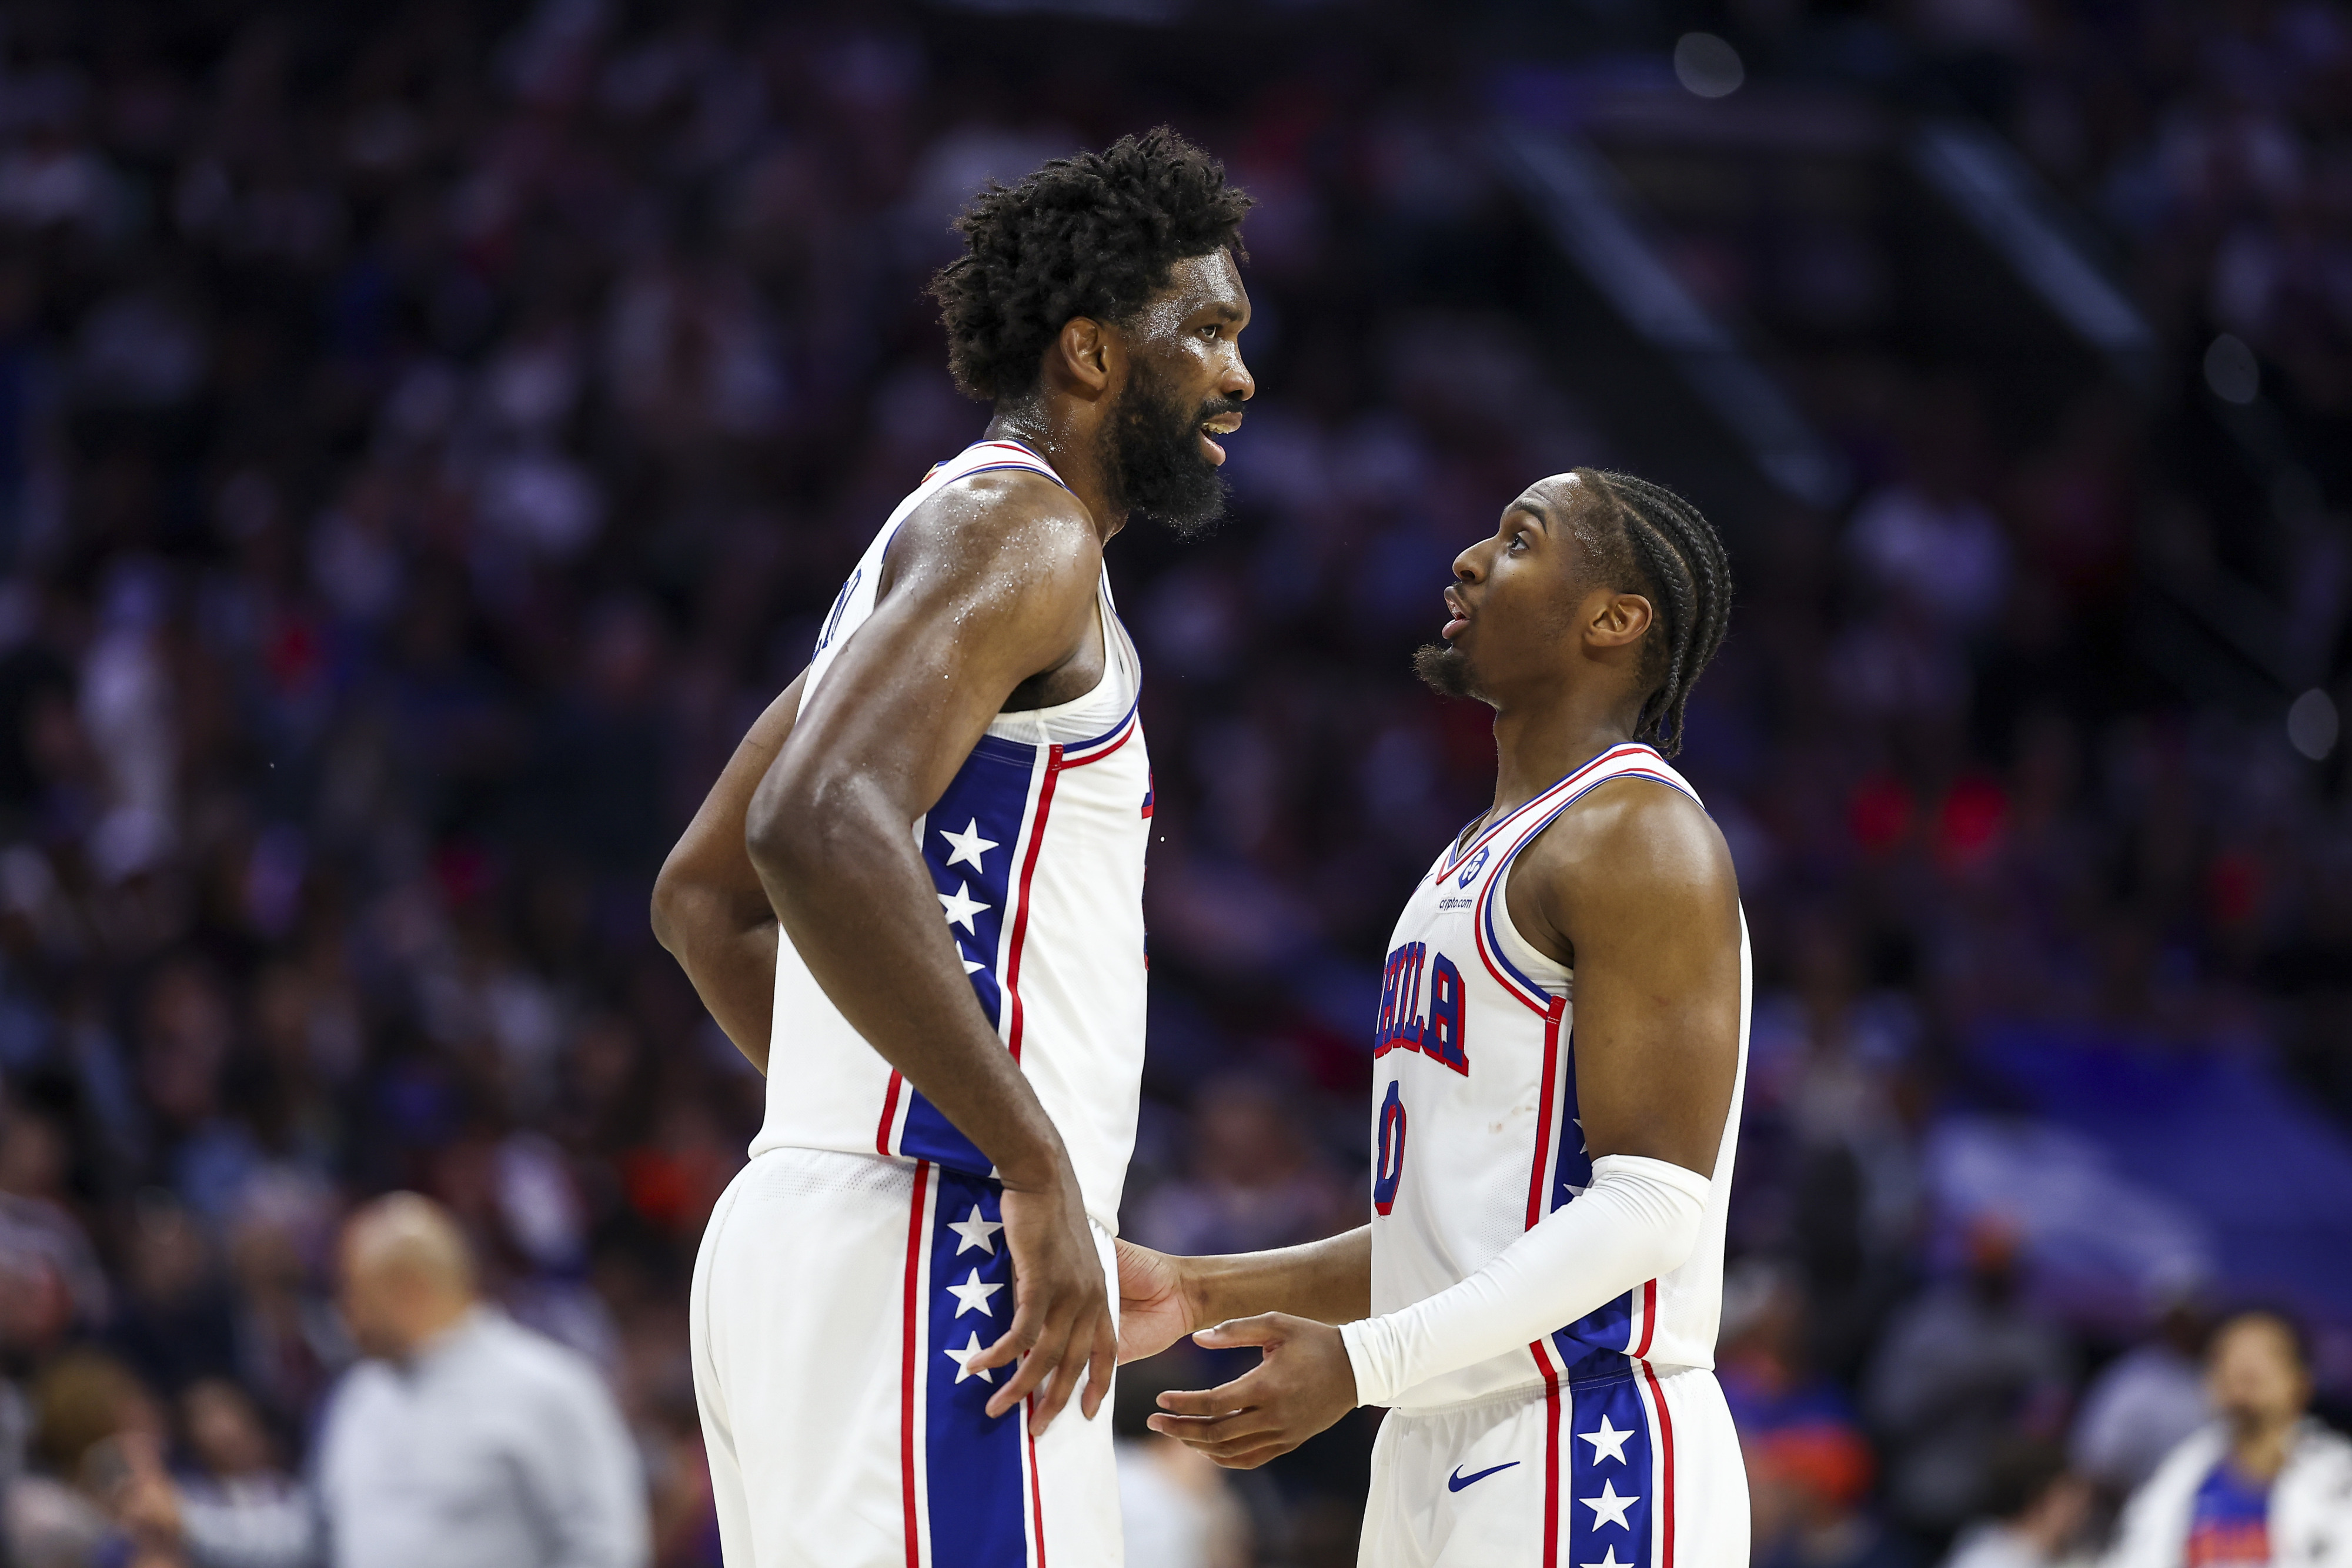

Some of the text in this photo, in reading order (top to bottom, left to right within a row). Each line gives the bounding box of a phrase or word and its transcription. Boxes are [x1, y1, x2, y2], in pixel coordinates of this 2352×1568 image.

[1439, 897, 1472, 911] crypto.com
[1374, 941, 1469, 1077] HILA
[1374, 1080, 1406, 1215] 0
